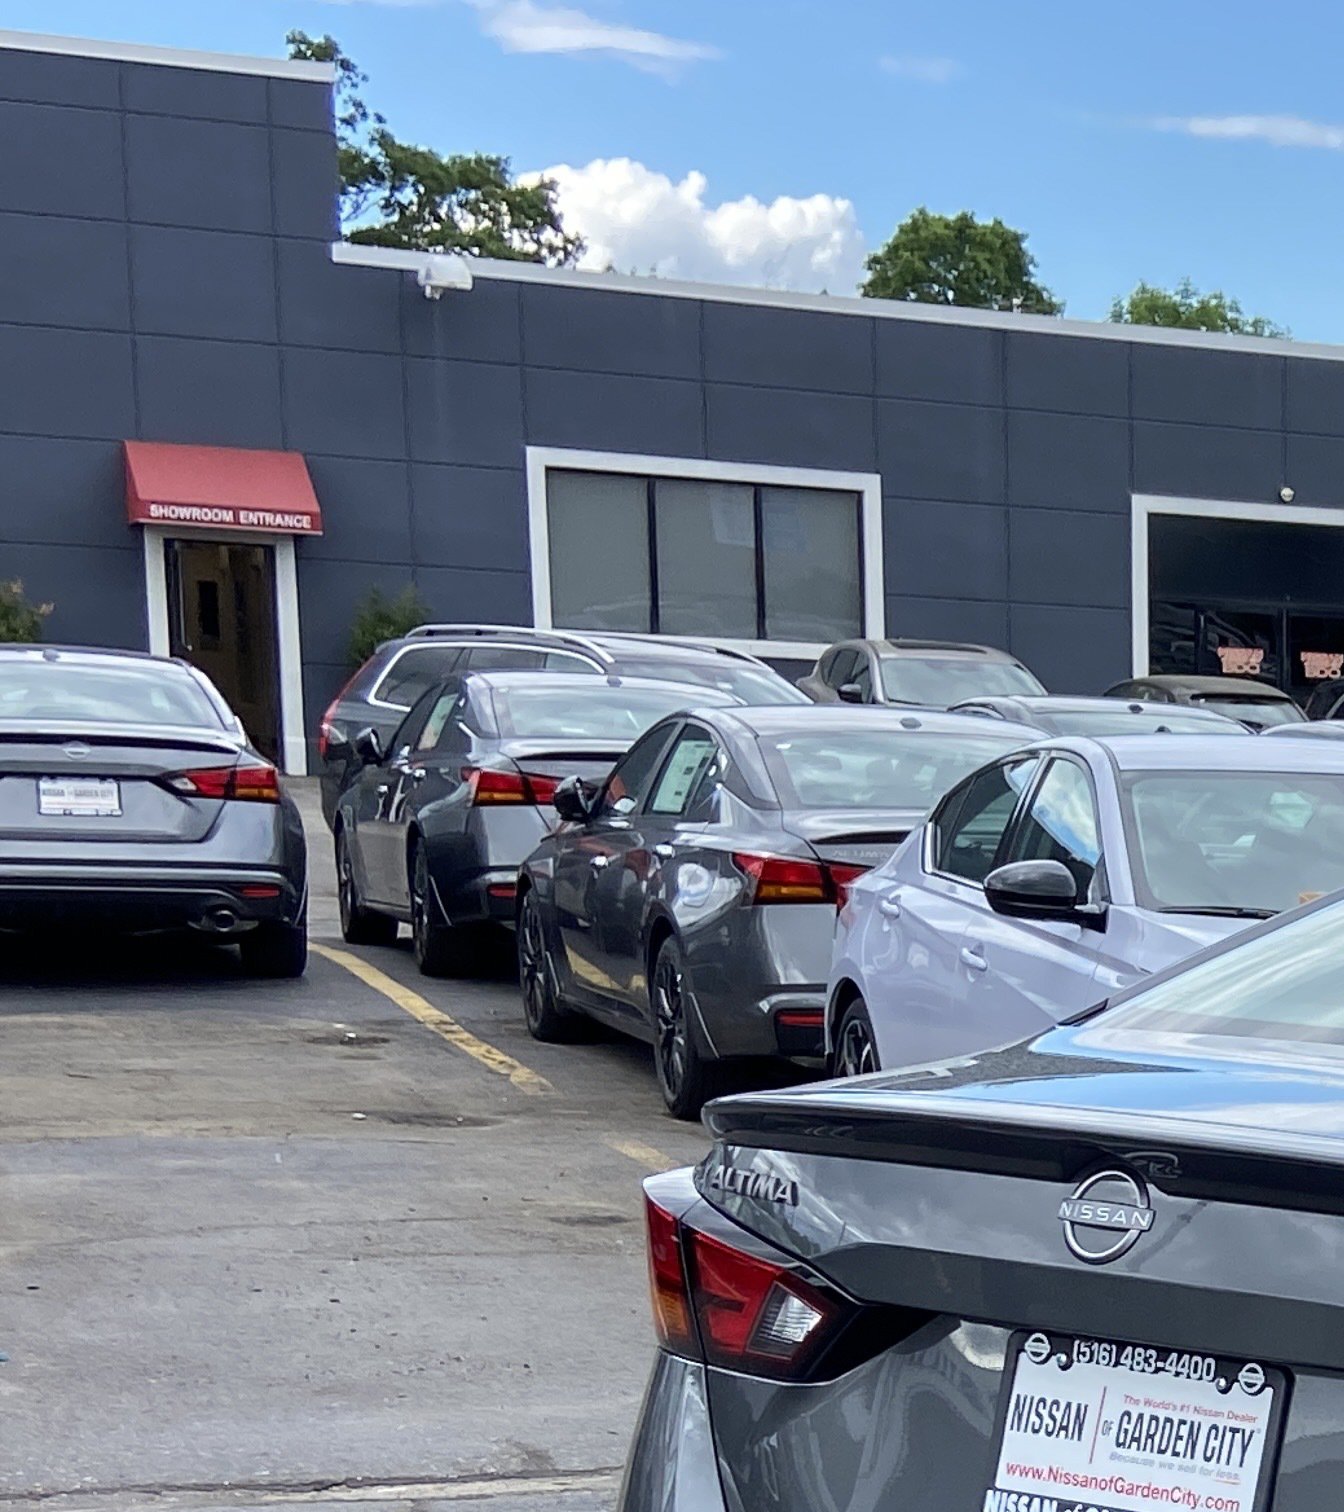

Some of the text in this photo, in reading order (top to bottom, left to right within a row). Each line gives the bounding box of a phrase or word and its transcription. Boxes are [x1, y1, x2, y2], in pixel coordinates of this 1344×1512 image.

[149, 503, 312, 529] SHOWROOM ENTRANCE
[711, 1165, 798, 1206] ALTIMA
[1058, 1201, 1150, 1227] NISSAN
[1072, 1339, 1216, 1381] (516) 483-4400
[1009, 1393, 1089, 1442] NISSAN
[1123, 1394, 1141, 1406] The
[1143, 1397, 1178, 1411] World's
[1193, 1405, 1226, 1418] Nissan
[1226, 1411, 1259, 1424] Dealer
[1101, 1409, 1256, 1468] OF GARDEN CITY
